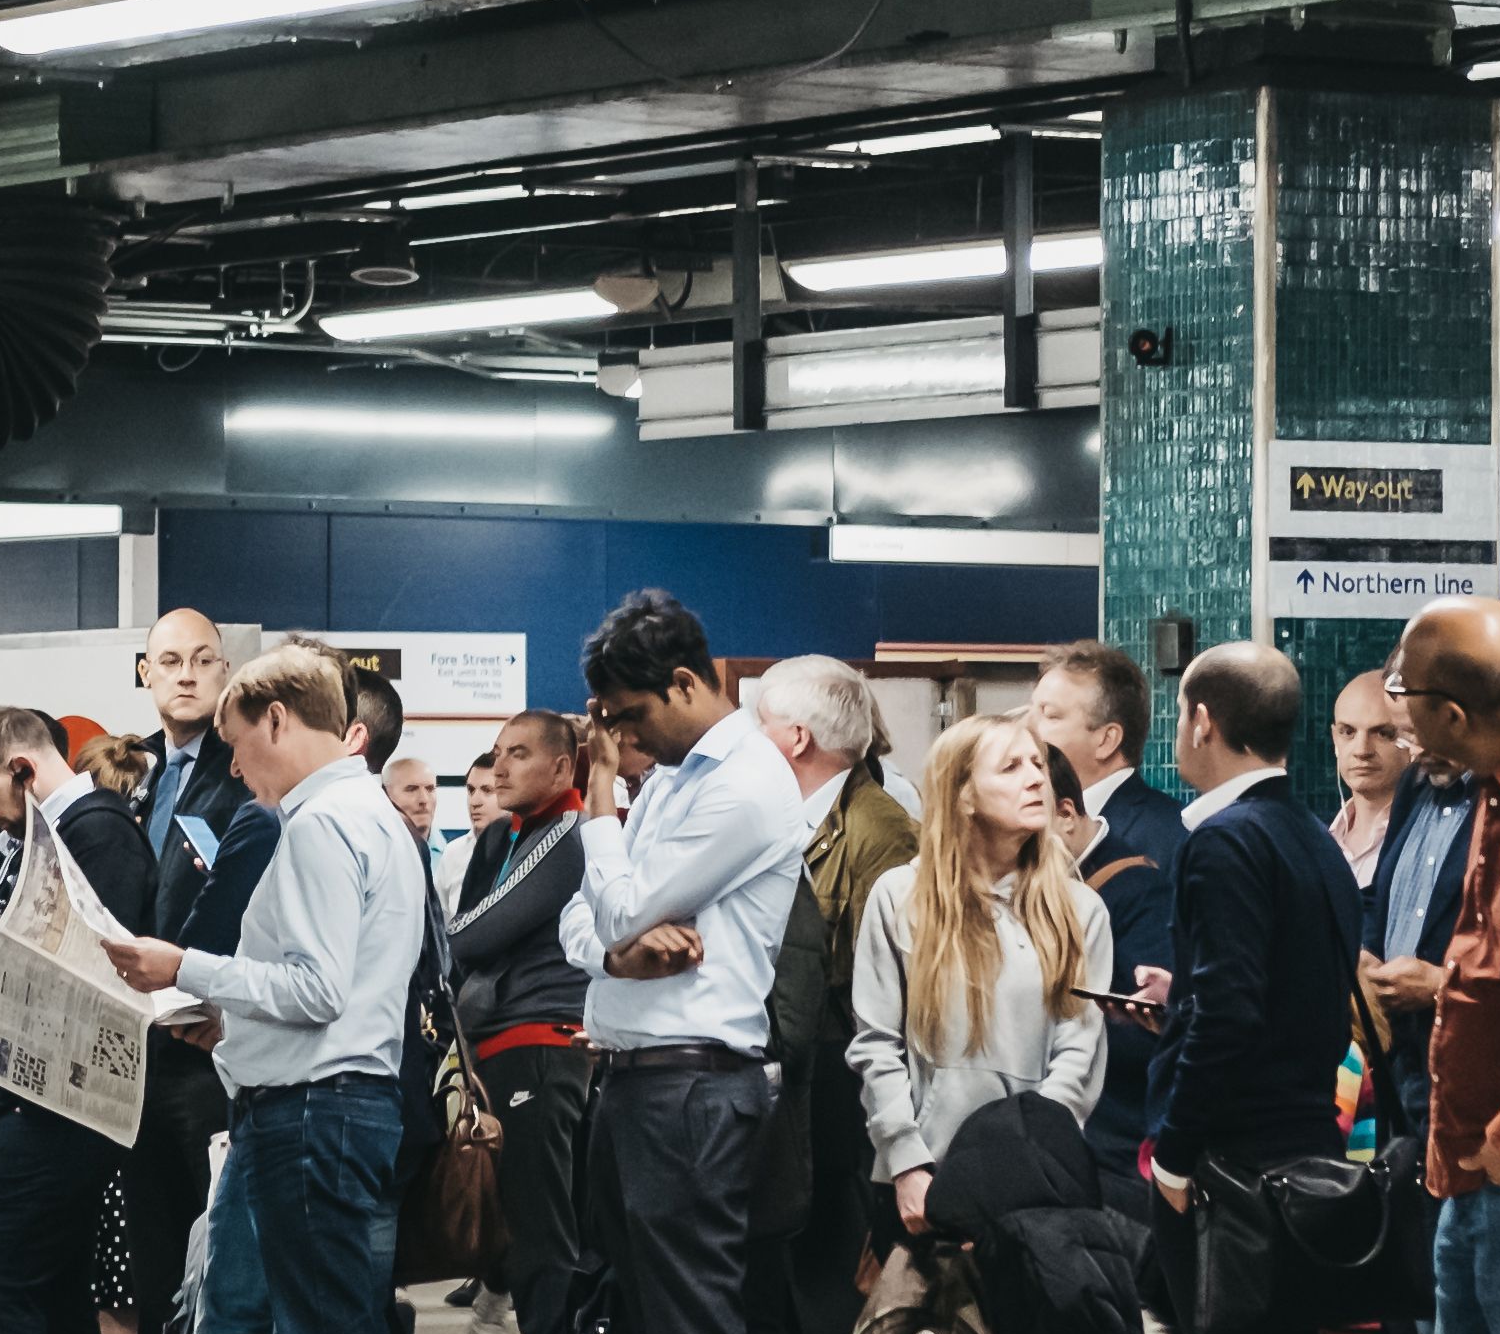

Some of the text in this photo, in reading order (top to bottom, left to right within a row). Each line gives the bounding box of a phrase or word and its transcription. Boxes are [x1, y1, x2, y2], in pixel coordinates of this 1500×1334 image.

[1320, 473, 1414, 505] Way out
[1322, 571, 1474, 596] Northern line
[430, 652, 501, 666] Fore Street
